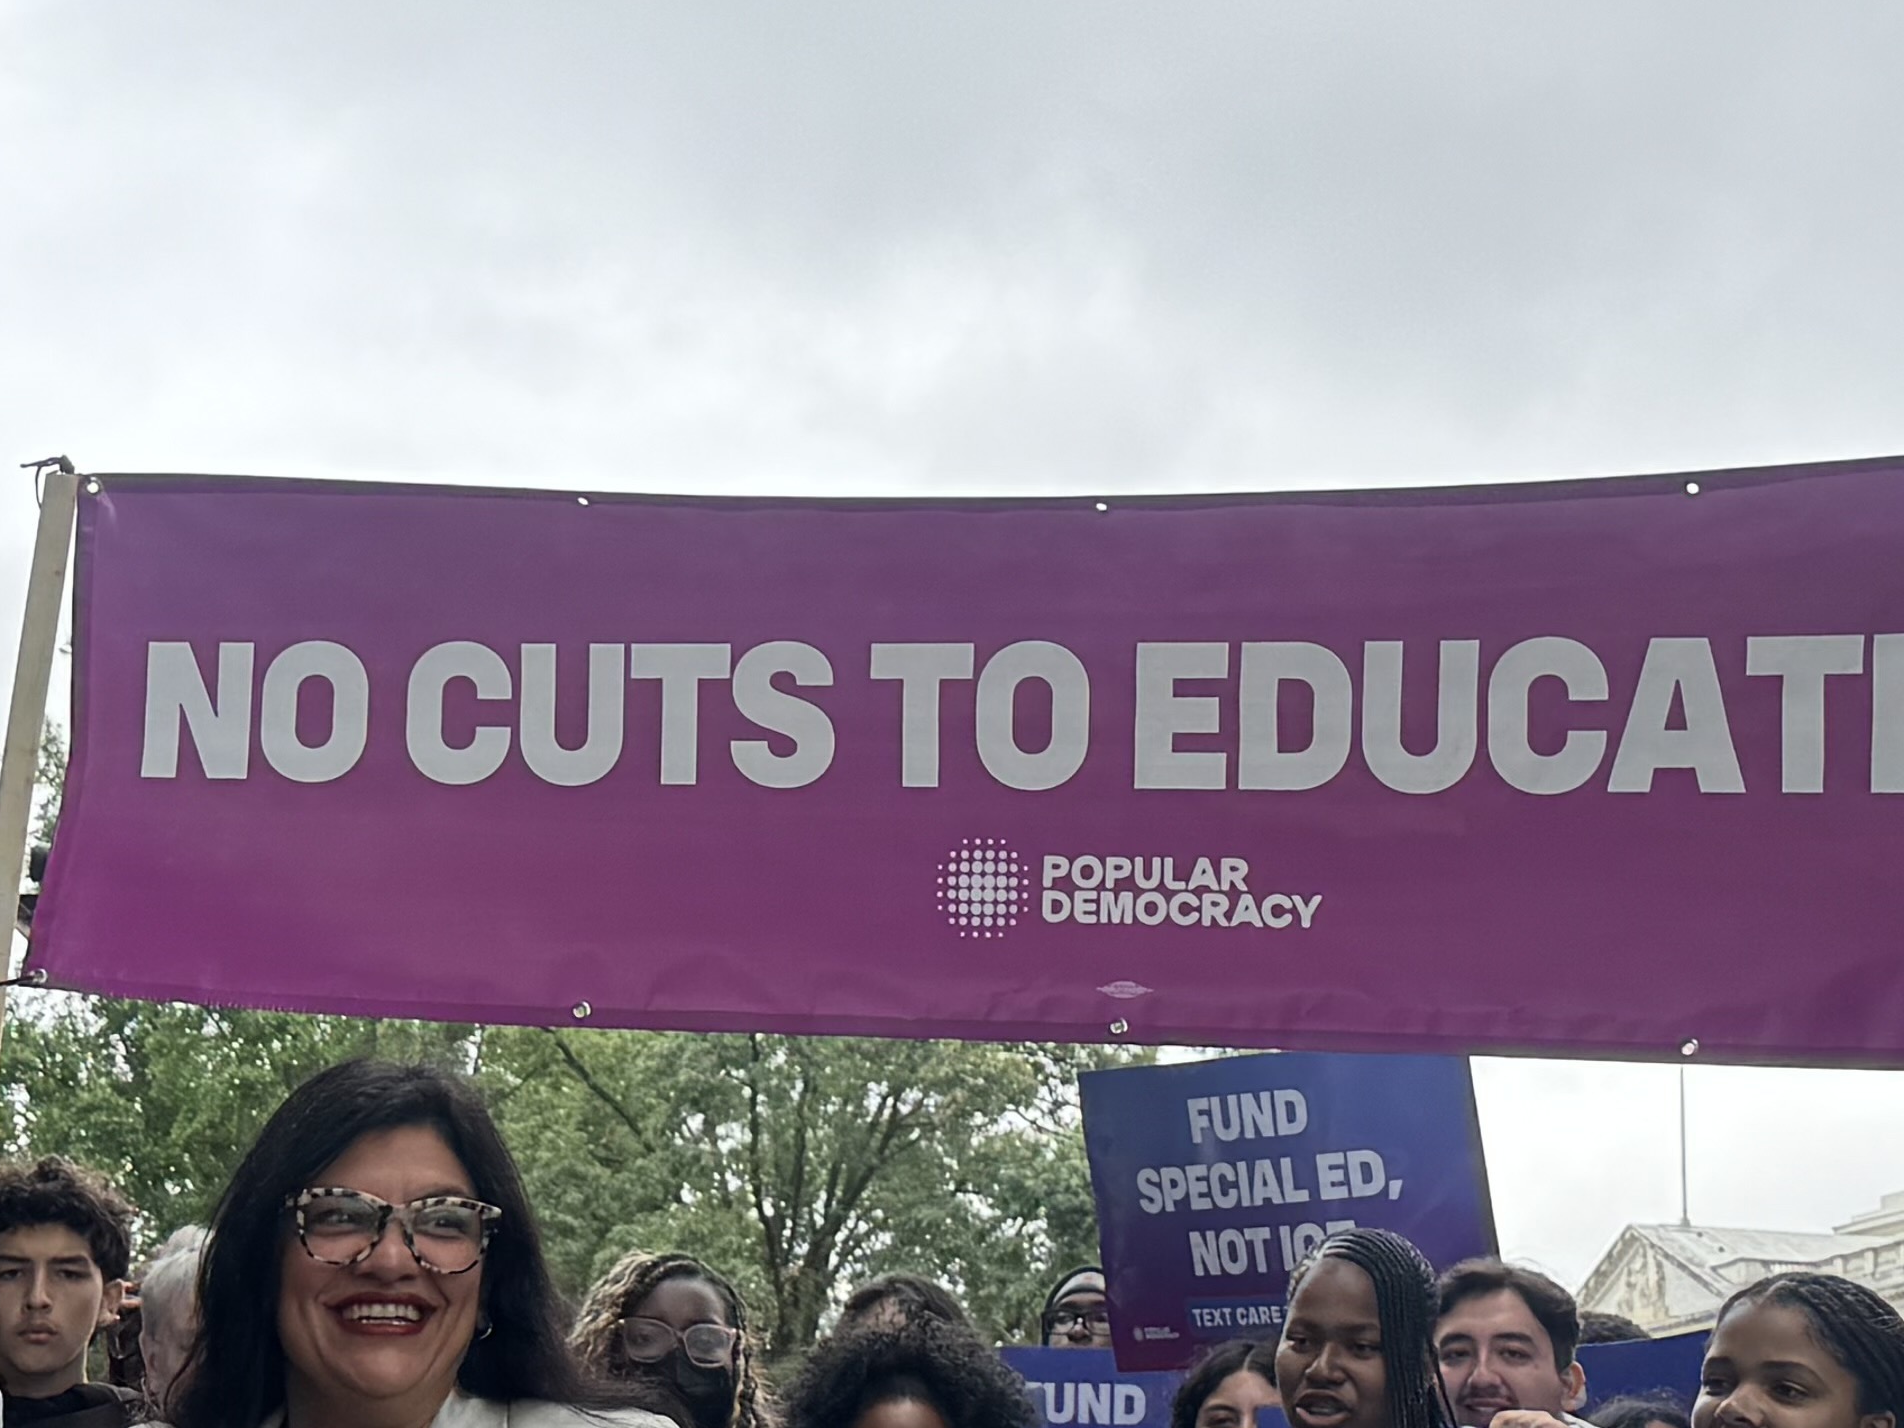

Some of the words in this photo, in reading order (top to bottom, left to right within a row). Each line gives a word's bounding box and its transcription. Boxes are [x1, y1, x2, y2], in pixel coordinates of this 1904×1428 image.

[141, 640, 370, 783] NO
[405, 640, 836, 789] CUTS
[869, 640, 1090, 791] TO
[1042, 854, 1249, 892] POPULAR
[1041, 889, 1323, 929] DEMOCRACY
[1187, 1088, 1308, 1144] FUND
[1136, 1156, 1310, 1214] SPECIAL
[1315, 1149, 1404, 1201] ED,
[1188, 1226, 1272, 1277] NOT
[1279, 1219, 1356, 1272] IC
[1191, 1307, 1232, 1327] TEXT
[1235, 1305, 1283, 1326] CARE
[1025, 1381, 1146, 1425] UND
